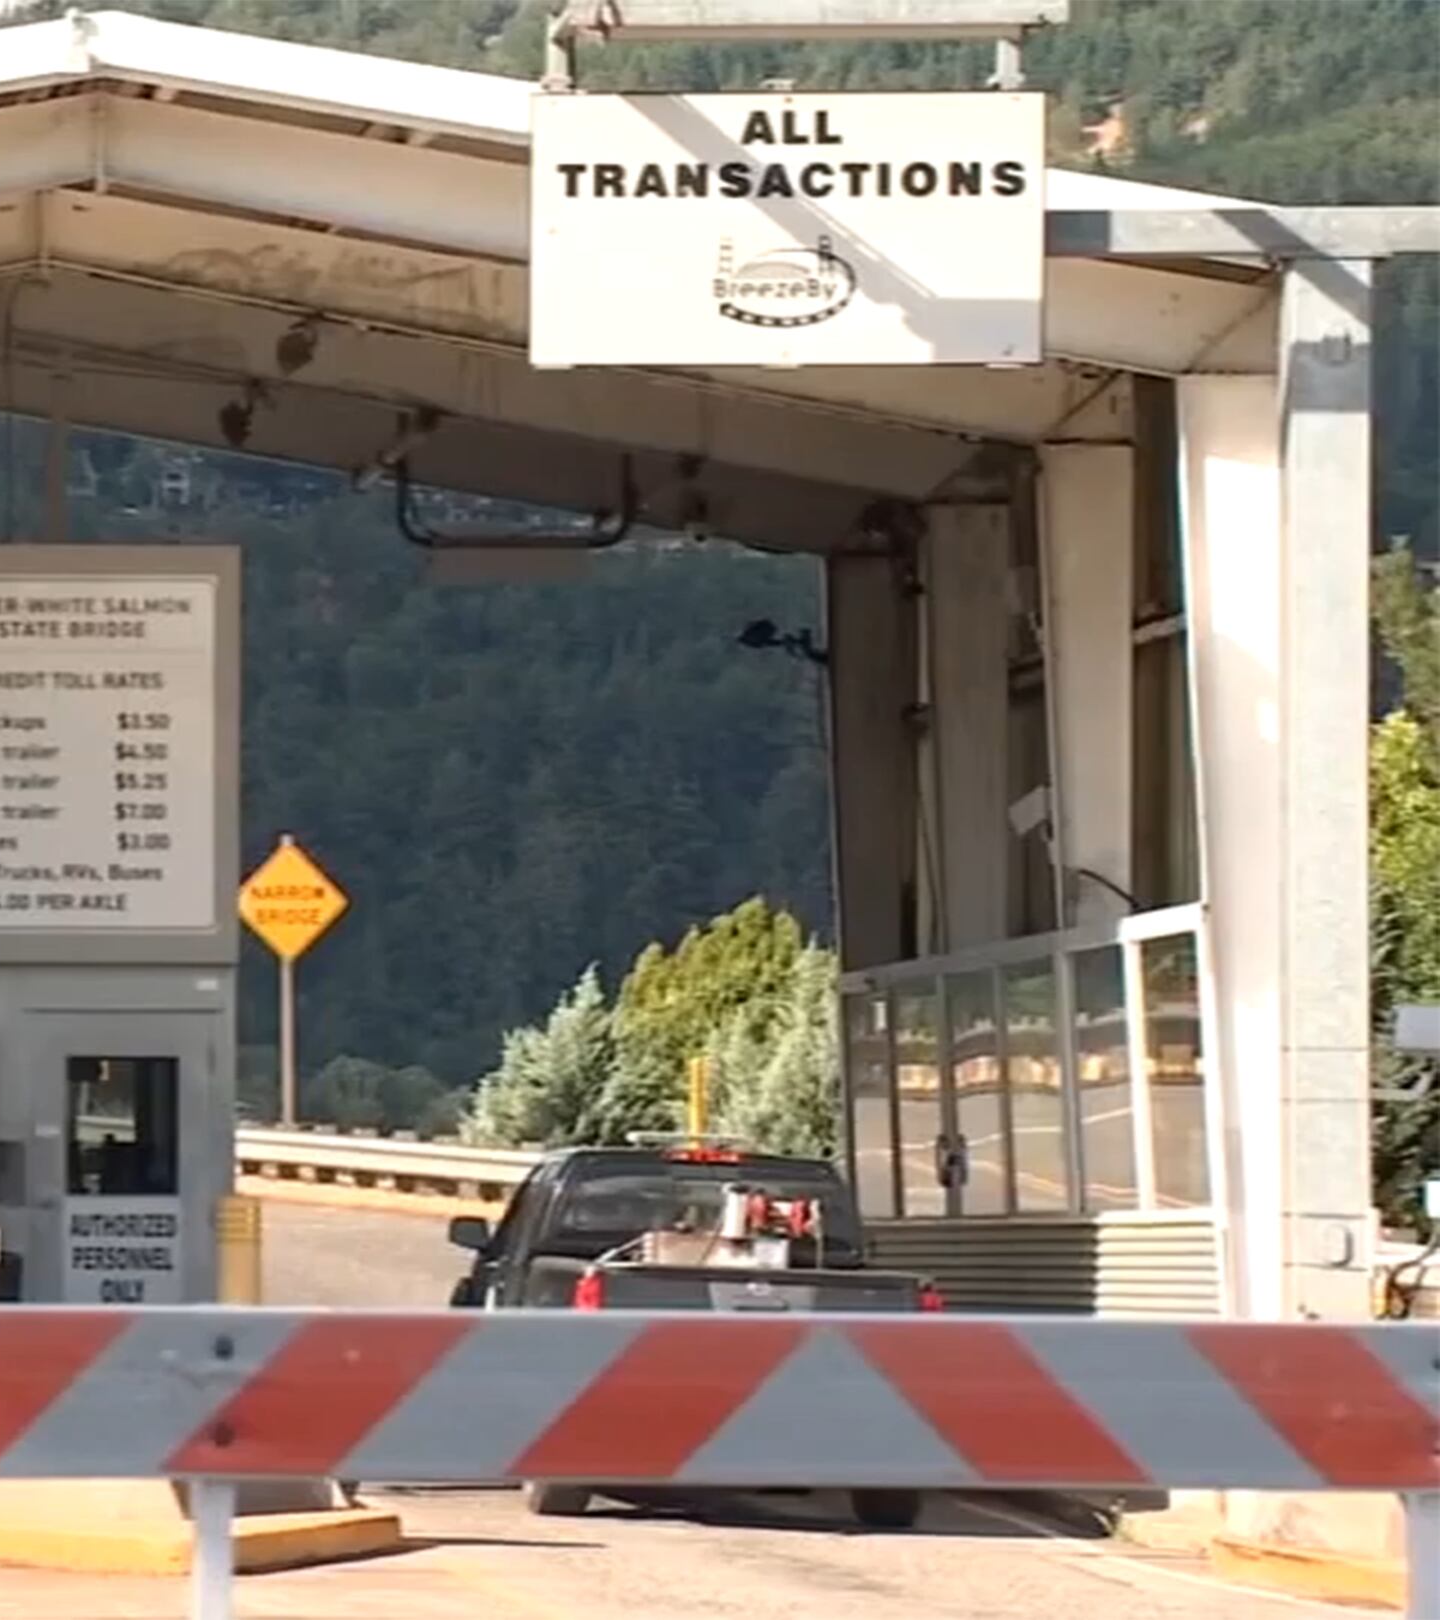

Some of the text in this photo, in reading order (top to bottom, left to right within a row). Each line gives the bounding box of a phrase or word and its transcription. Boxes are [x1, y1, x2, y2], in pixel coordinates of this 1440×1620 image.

[741, 110, 843, 144] ALL
[557, 161, 1026, 198] TRANSACTIONS
[713, 277, 838, 300] BreezeBy
[105, 597, 190, 614] SALMON
[68, 621, 146, 638] BRIDGE
[53, 672, 96, 689] TOLL
[103, 672, 164, 689] RATES
[117, 712, 171, 731] $3.50
[2, 743, 61, 759] trailer
[115, 742, 169, 761] $4.50
[2, 773, 61, 789] trailer
[115, 772, 169, 791] $5.25
[2, 803, 61, 819] trailer
[115, 802, 167, 821] $7.00
[117, 832, 171, 851] $3.00
[62, 864, 103, 882] RVs,
[108, 864, 163, 880] Buses
[36, 893, 75, 910] PER
[80, 893, 127, 910] AXLE
[250, 885, 325, 901] NARROW
[256, 908, 321, 925] BRIDGE
[71, 1214, 177, 1237] AUTHORIZED
[72, 1247, 173, 1270] PERSONNEL
[101, 1279, 144, 1303] ONLY
